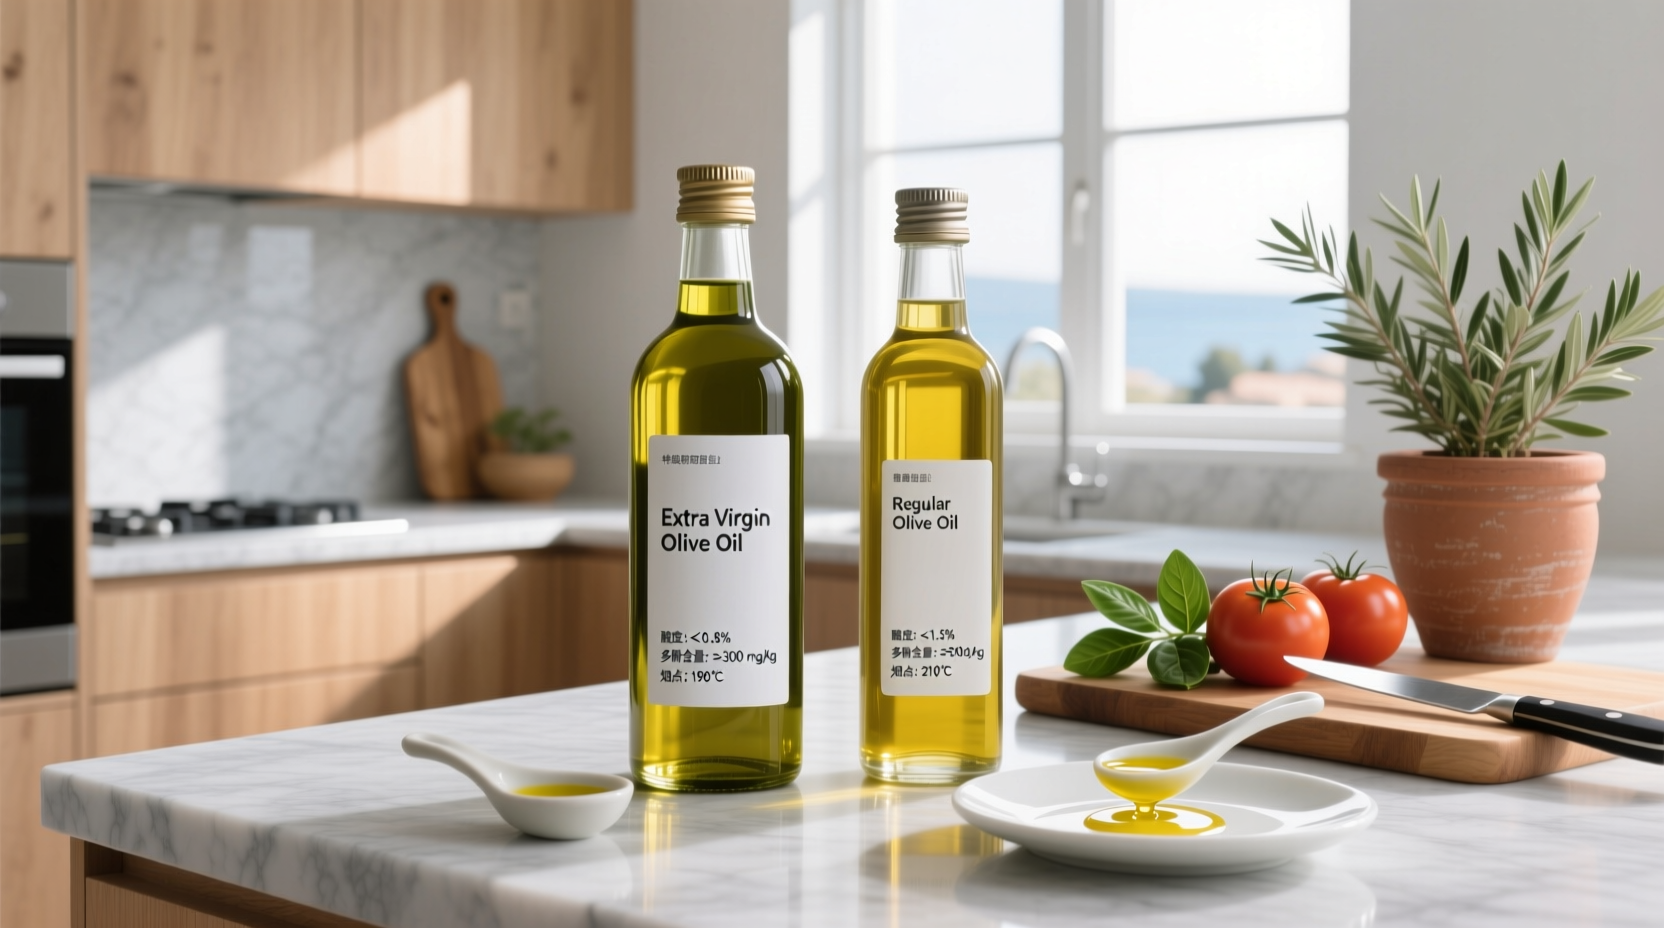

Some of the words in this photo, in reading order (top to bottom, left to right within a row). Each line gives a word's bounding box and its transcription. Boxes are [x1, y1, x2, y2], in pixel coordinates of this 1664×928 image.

[892, 495, 951, 515] Regular
[661, 507, 709, 526] Extra
[713, 507, 771, 532] Virgin
[892, 514, 932, 530] Olive
[936, 514, 958, 530] Oil
[661, 532, 711, 552] Olive
[715, 532, 743, 552] Oil
